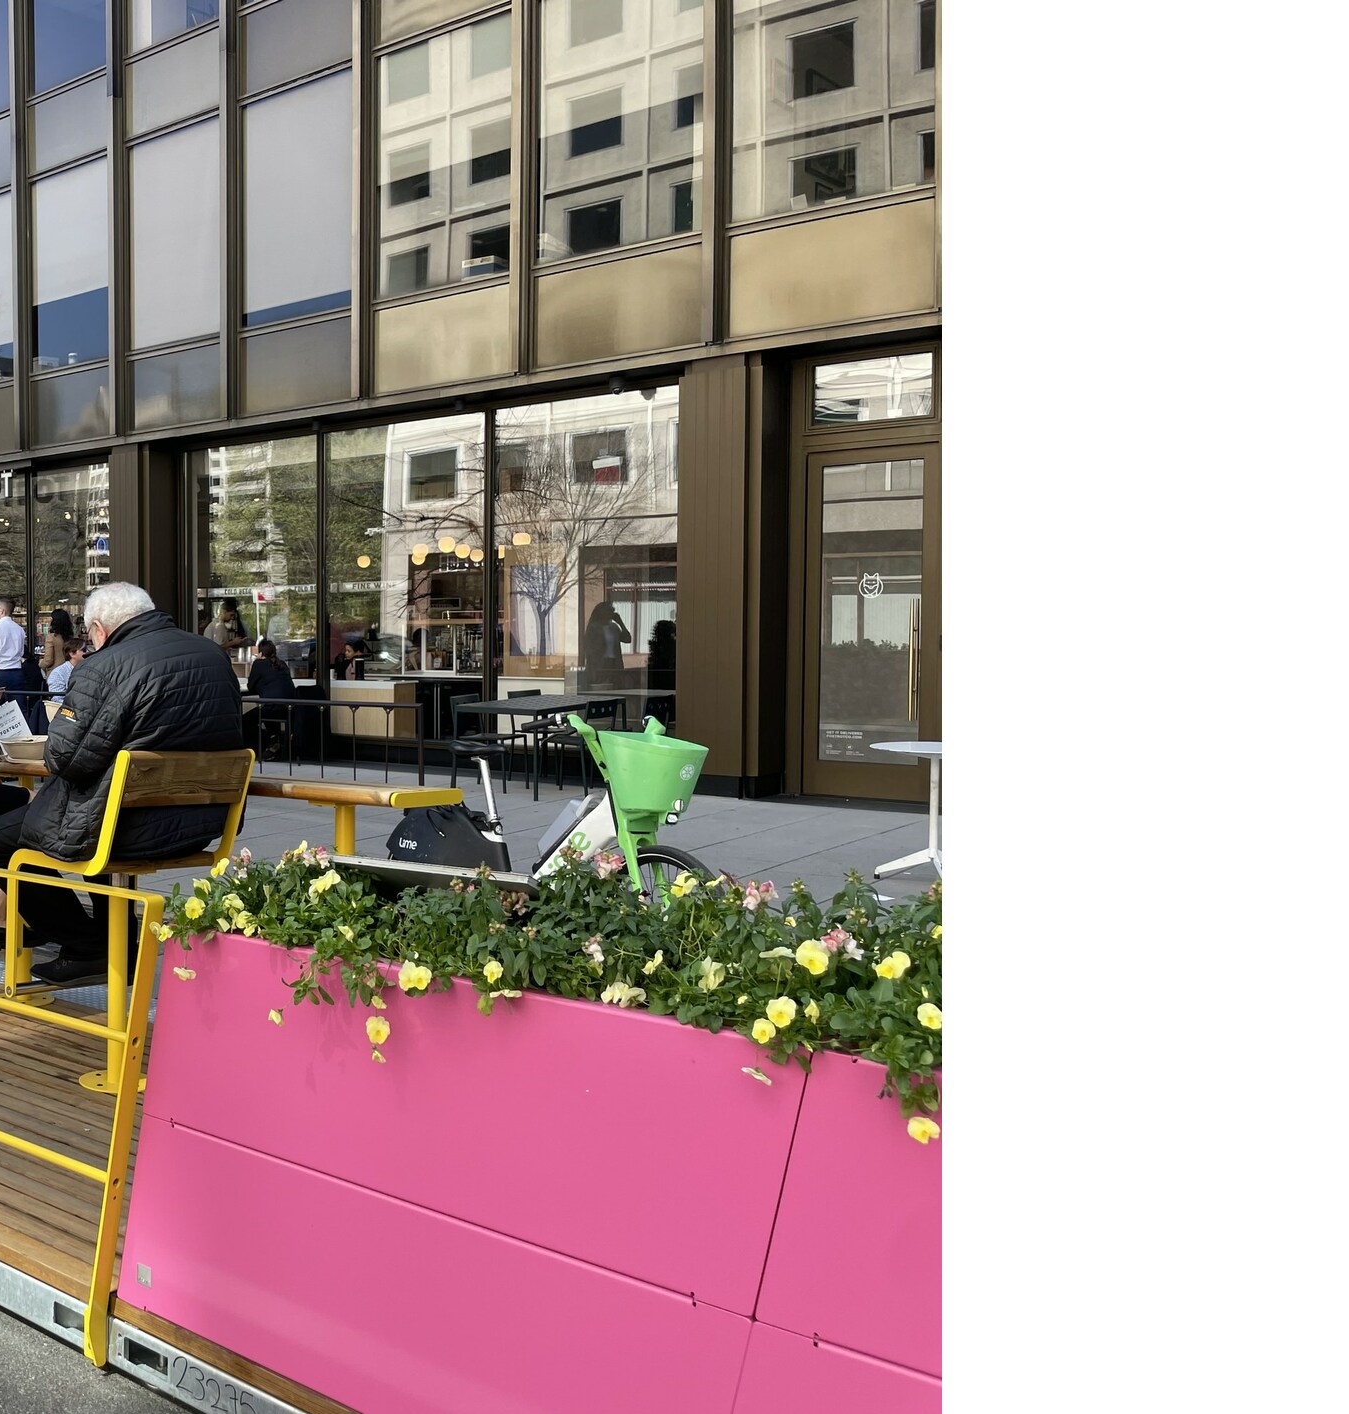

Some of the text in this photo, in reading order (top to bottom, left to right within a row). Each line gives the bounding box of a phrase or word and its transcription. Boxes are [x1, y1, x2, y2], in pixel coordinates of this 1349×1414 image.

[352, 582, 371, 590] FINE
[0, 722, 21, 735] FOXTROT
[172, 1356, 257, 1414] 23275
